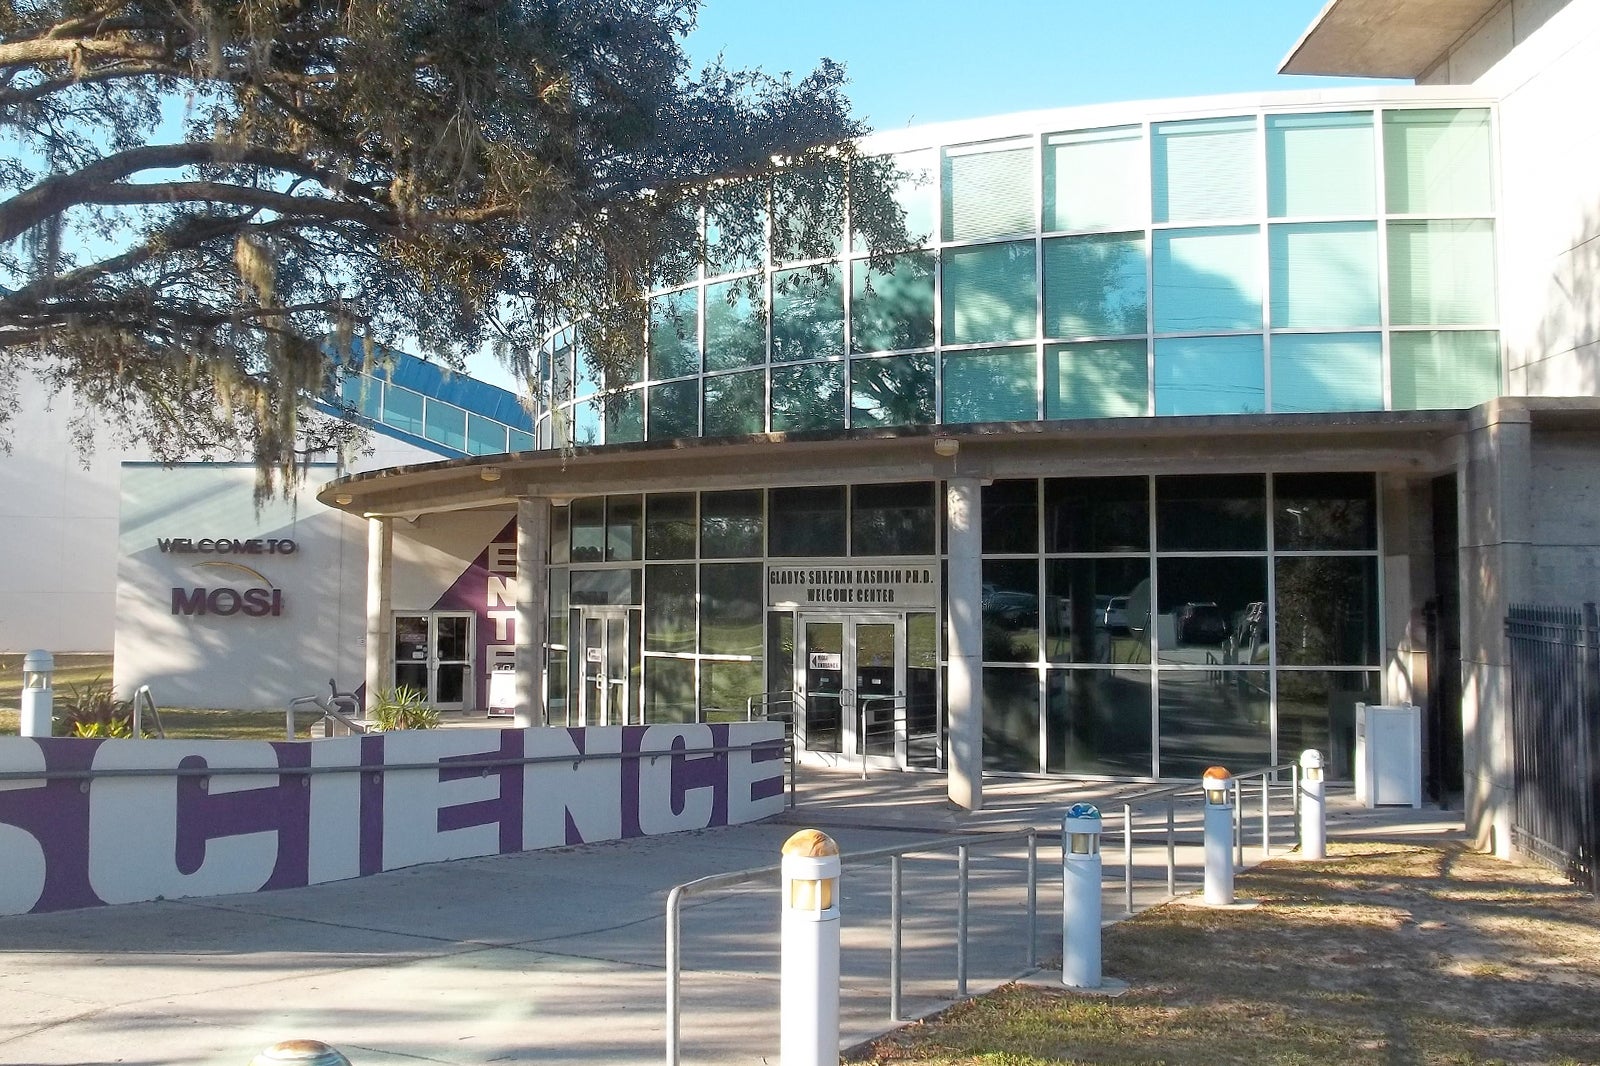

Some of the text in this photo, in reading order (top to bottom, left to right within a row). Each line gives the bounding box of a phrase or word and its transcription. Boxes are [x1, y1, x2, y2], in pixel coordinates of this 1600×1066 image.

[157, 537, 297, 555] WELCOME TO
[770, 570, 806, 585] GLADYS
[808, 570, 853, 585] SHAFRAN
[905, 569, 934, 584] PH.D.
[171, 587, 282, 617] MOSI
[807, 588, 895, 603] WELCOME CENTER
